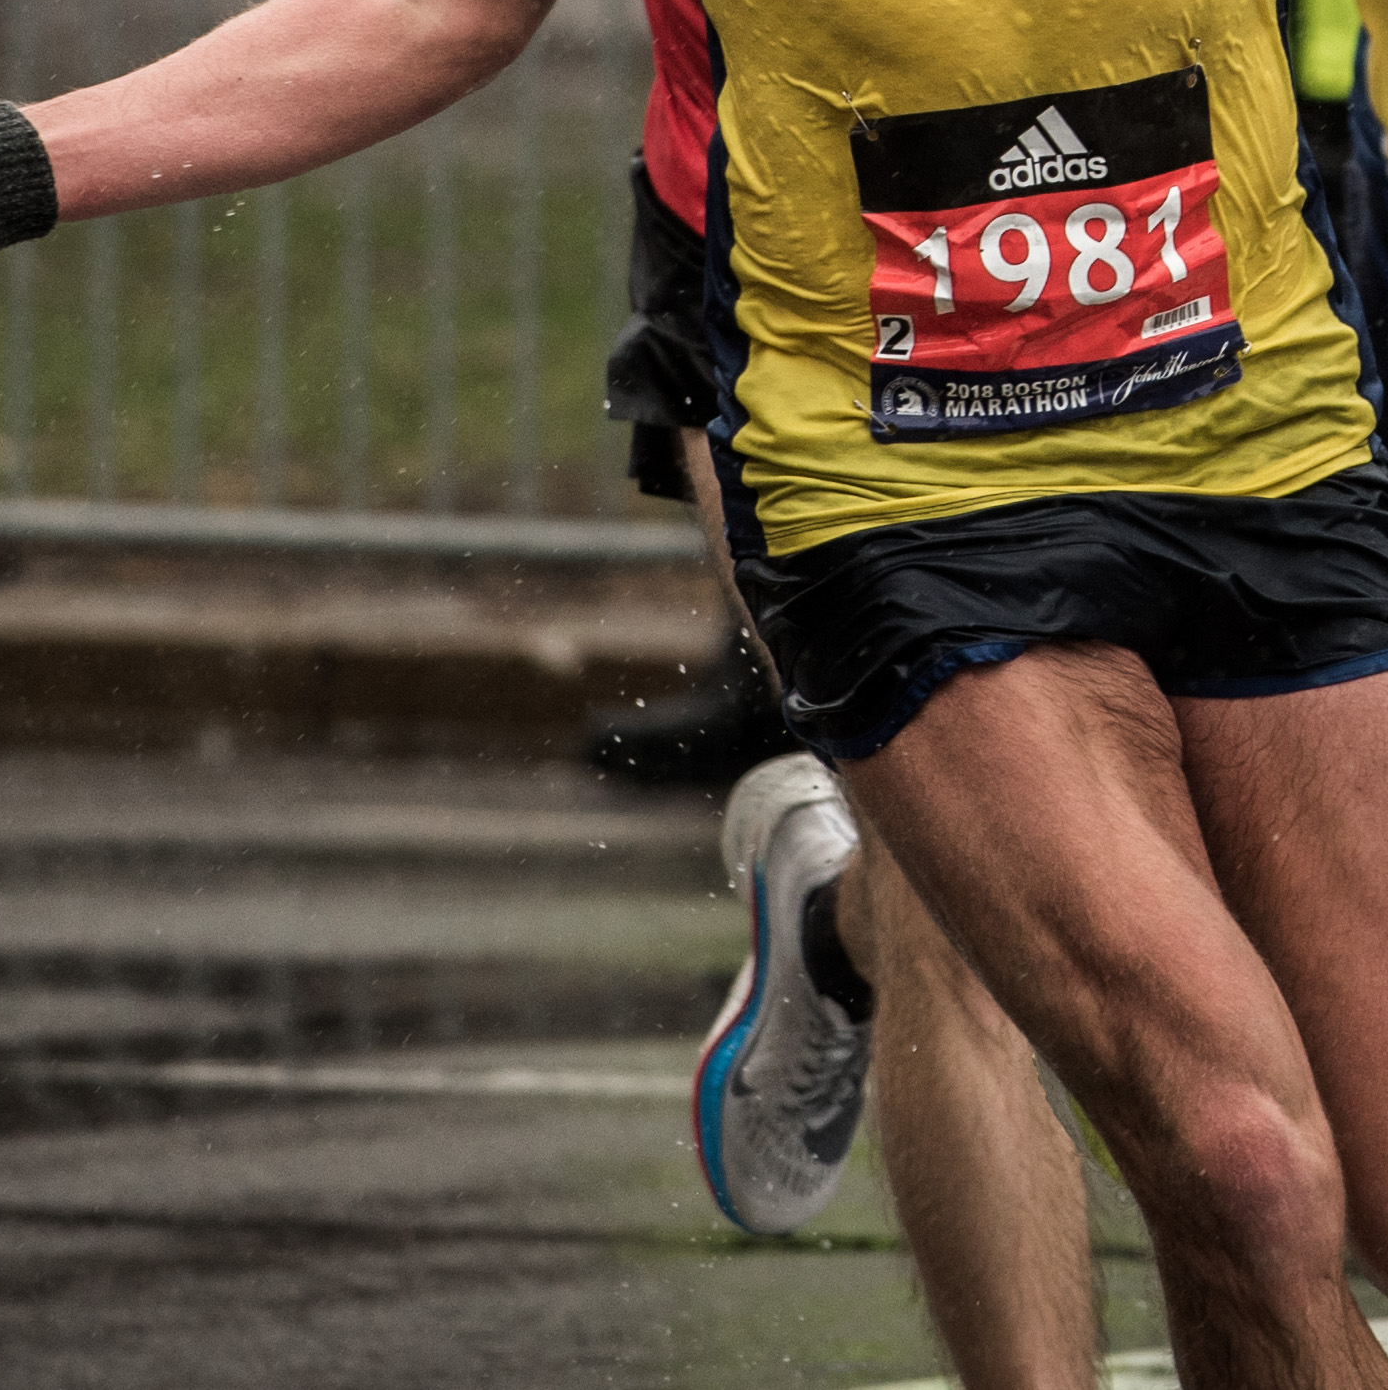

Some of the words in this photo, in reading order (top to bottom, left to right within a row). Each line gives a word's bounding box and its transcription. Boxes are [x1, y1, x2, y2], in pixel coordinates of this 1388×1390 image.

[988, 153, 1109, 192] adidas
[913, 184, 1189, 316] 1981
[879, 316, 912, 357] 2
[944, 387, 1089, 418] MARATHON
[945, 382, 994, 400] 2018
[1001, 374, 1087, 397] BOSTON
